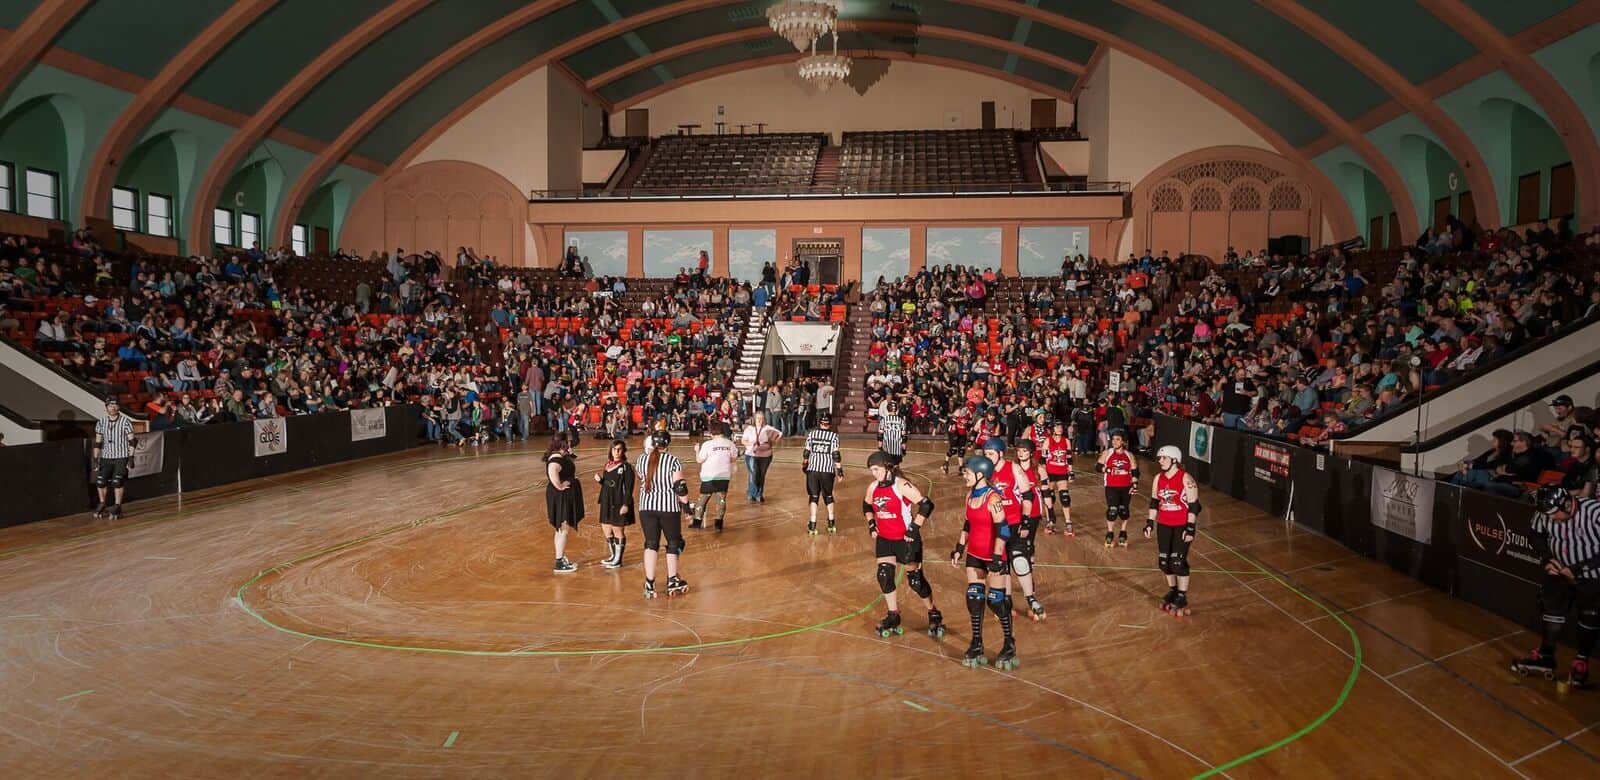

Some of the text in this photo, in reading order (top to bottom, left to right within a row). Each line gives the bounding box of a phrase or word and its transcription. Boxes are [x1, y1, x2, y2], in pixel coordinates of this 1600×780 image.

[1449, 172, 1458, 191] G
[235, 191, 245, 207] C
[1072, 231, 1082, 247] F
[1475, 523, 1504, 541] PULSE
